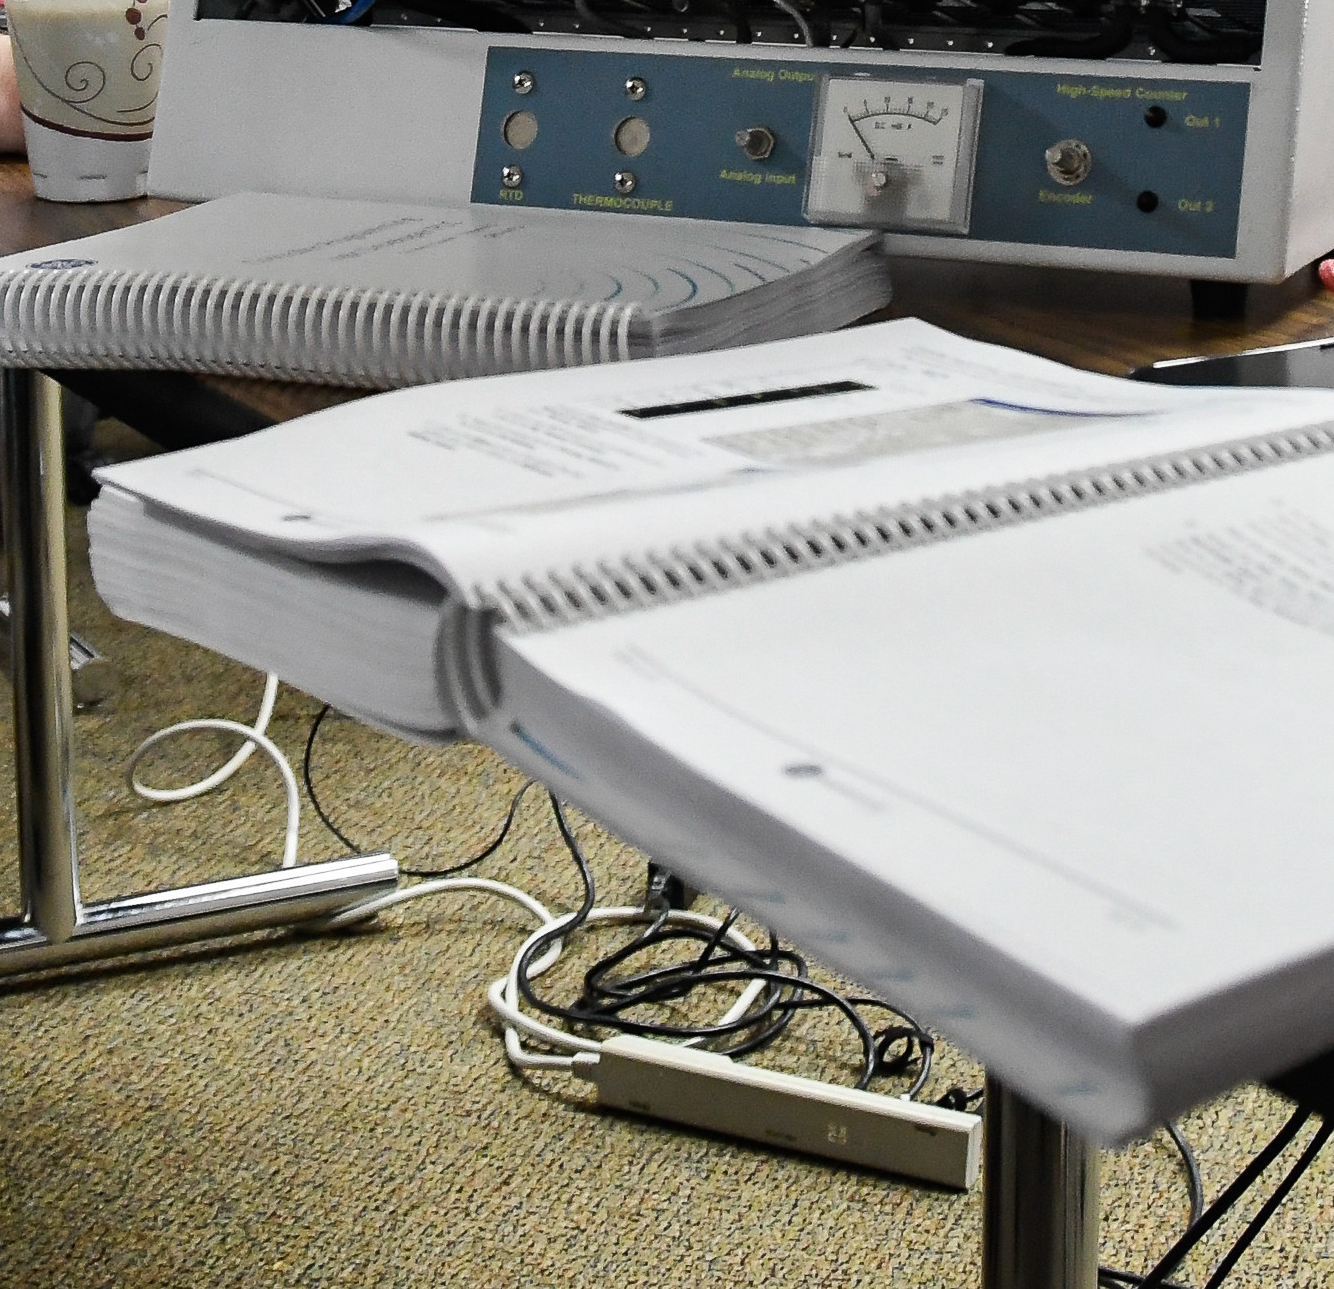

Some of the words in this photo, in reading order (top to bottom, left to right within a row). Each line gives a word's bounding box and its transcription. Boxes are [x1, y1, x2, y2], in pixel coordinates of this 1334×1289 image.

[731, 67, 775, 83] Analog
[777, 68, 817, 85] Outpu
[1056, 82, 1132, 99] High-Speed
[1135, 87, 1188, 102] Counter
[1185, 114, 1210, 128] Out
[719, 168, 763, 185] Analog
[764, 171, 797, 185] Input
[499, 189, 524, 202] RTD
[572, 193, 673, 212] THERMOCOUPLE
[1038, 189, 1093, 205] Encoder
[1177, 198, 1203, 212] Out
